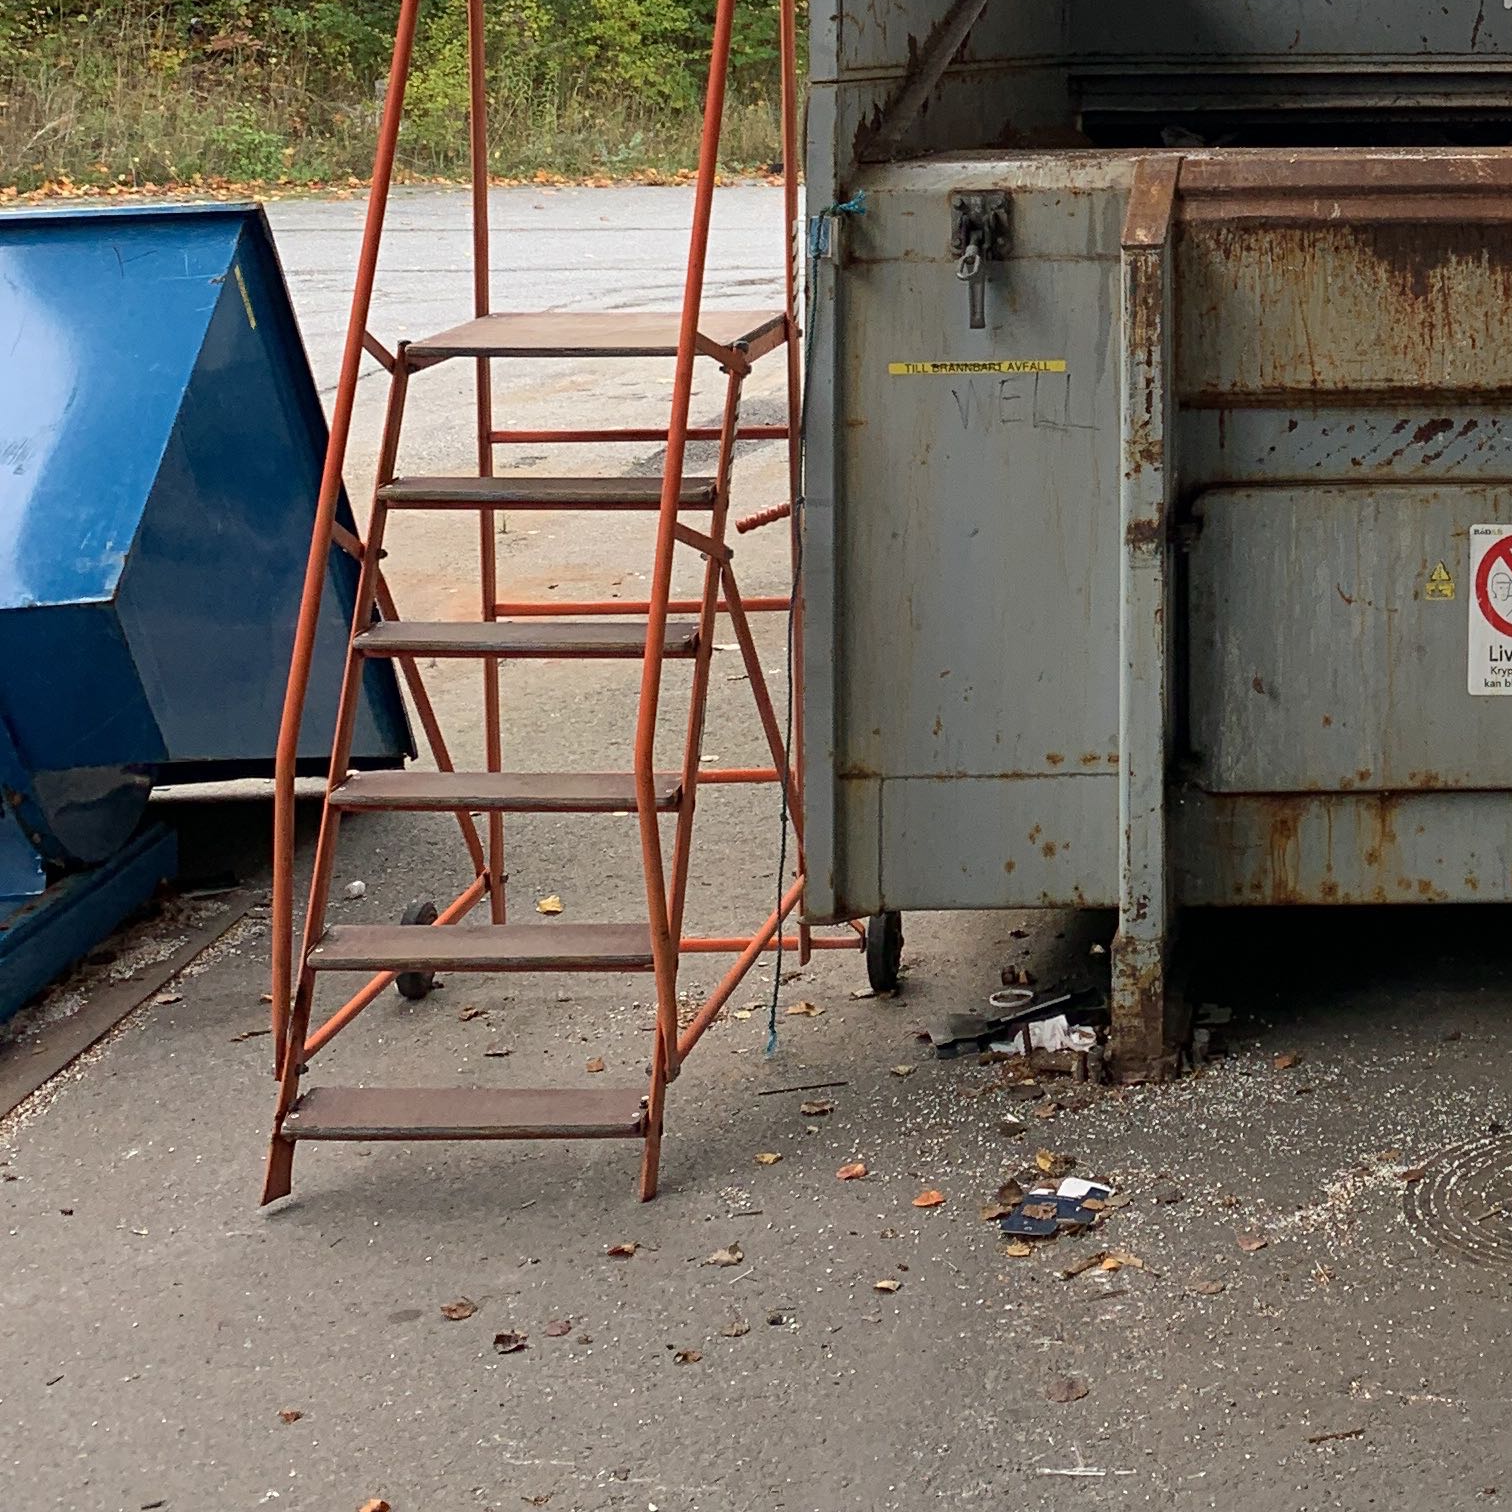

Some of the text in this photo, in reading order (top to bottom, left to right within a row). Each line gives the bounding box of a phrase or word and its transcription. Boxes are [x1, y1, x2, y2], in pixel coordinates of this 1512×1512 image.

[904, 363, 929, 374] TILL
[1006, 361, 1052, 373] AVFALL
[1484, 678, 1502, 688] kan
